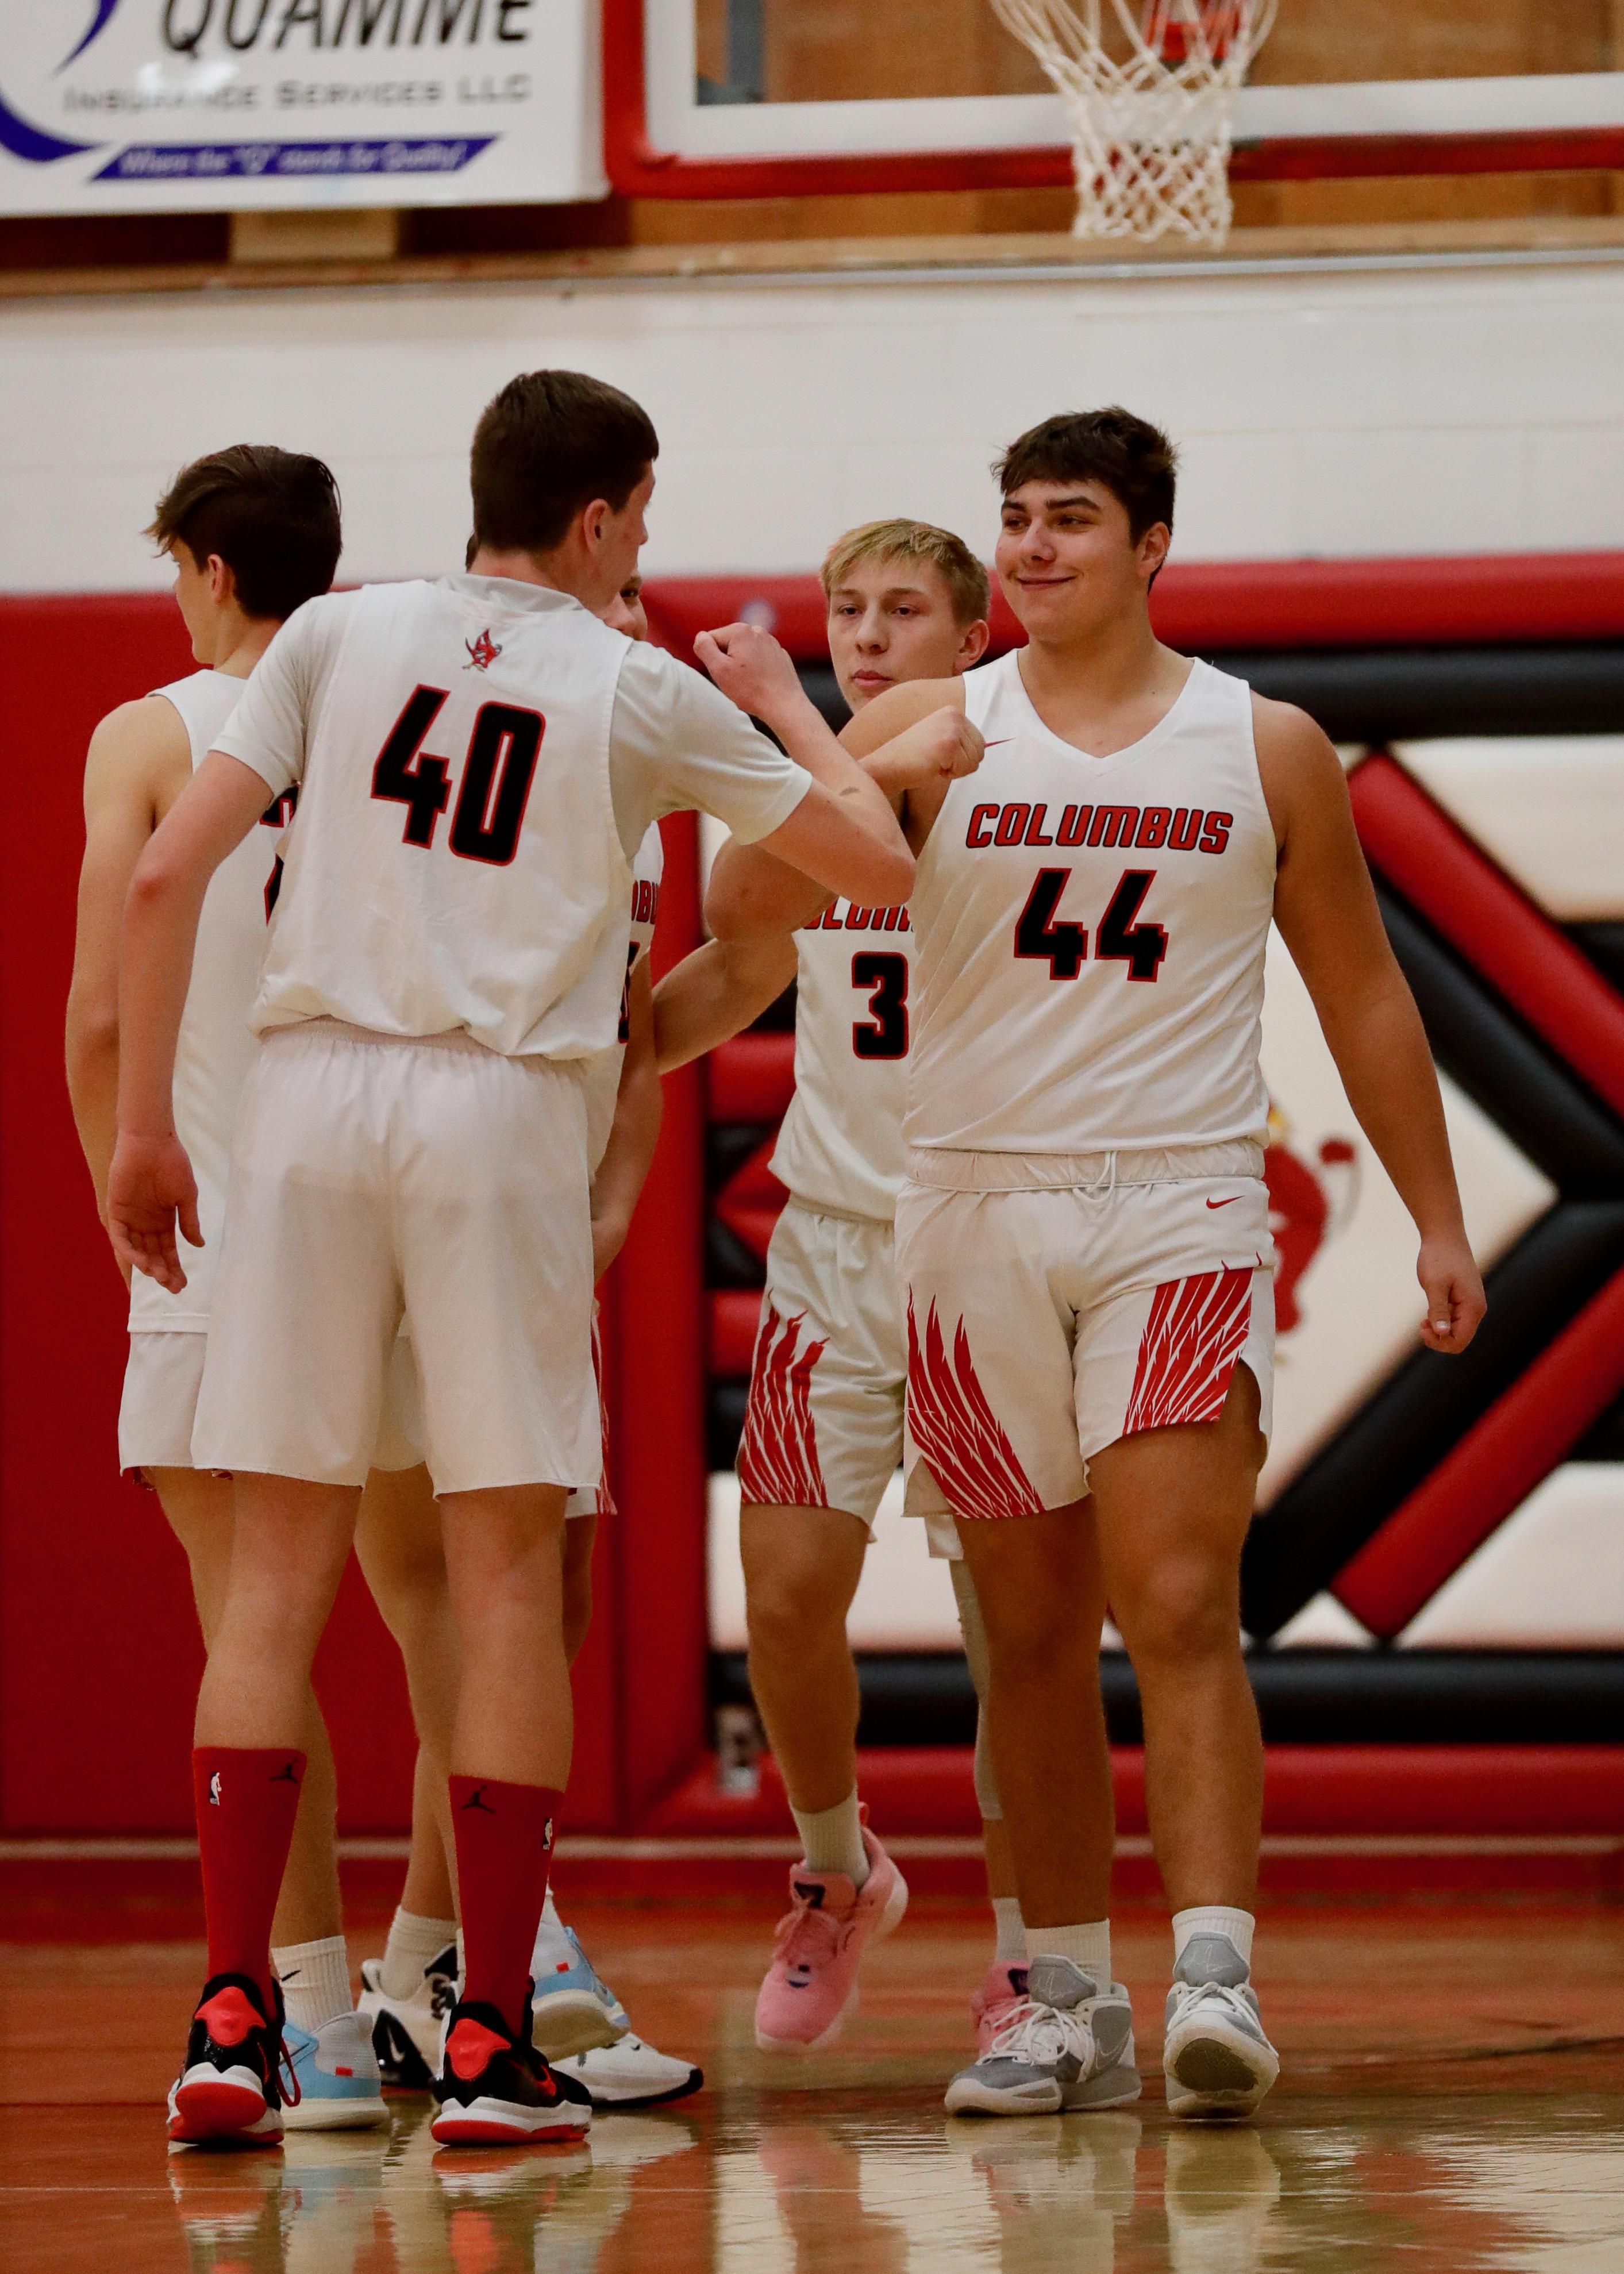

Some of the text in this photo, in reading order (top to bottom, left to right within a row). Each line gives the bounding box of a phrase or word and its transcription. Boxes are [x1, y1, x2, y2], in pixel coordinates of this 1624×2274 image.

[459, 73, 530, 104] LLC
[371, 683, 546, 866] 40
[966, 803, 1233, 855] COLUMBUS
[1014, 868, 1168, 982] 44
[851, 951, 909, 1060] 3
